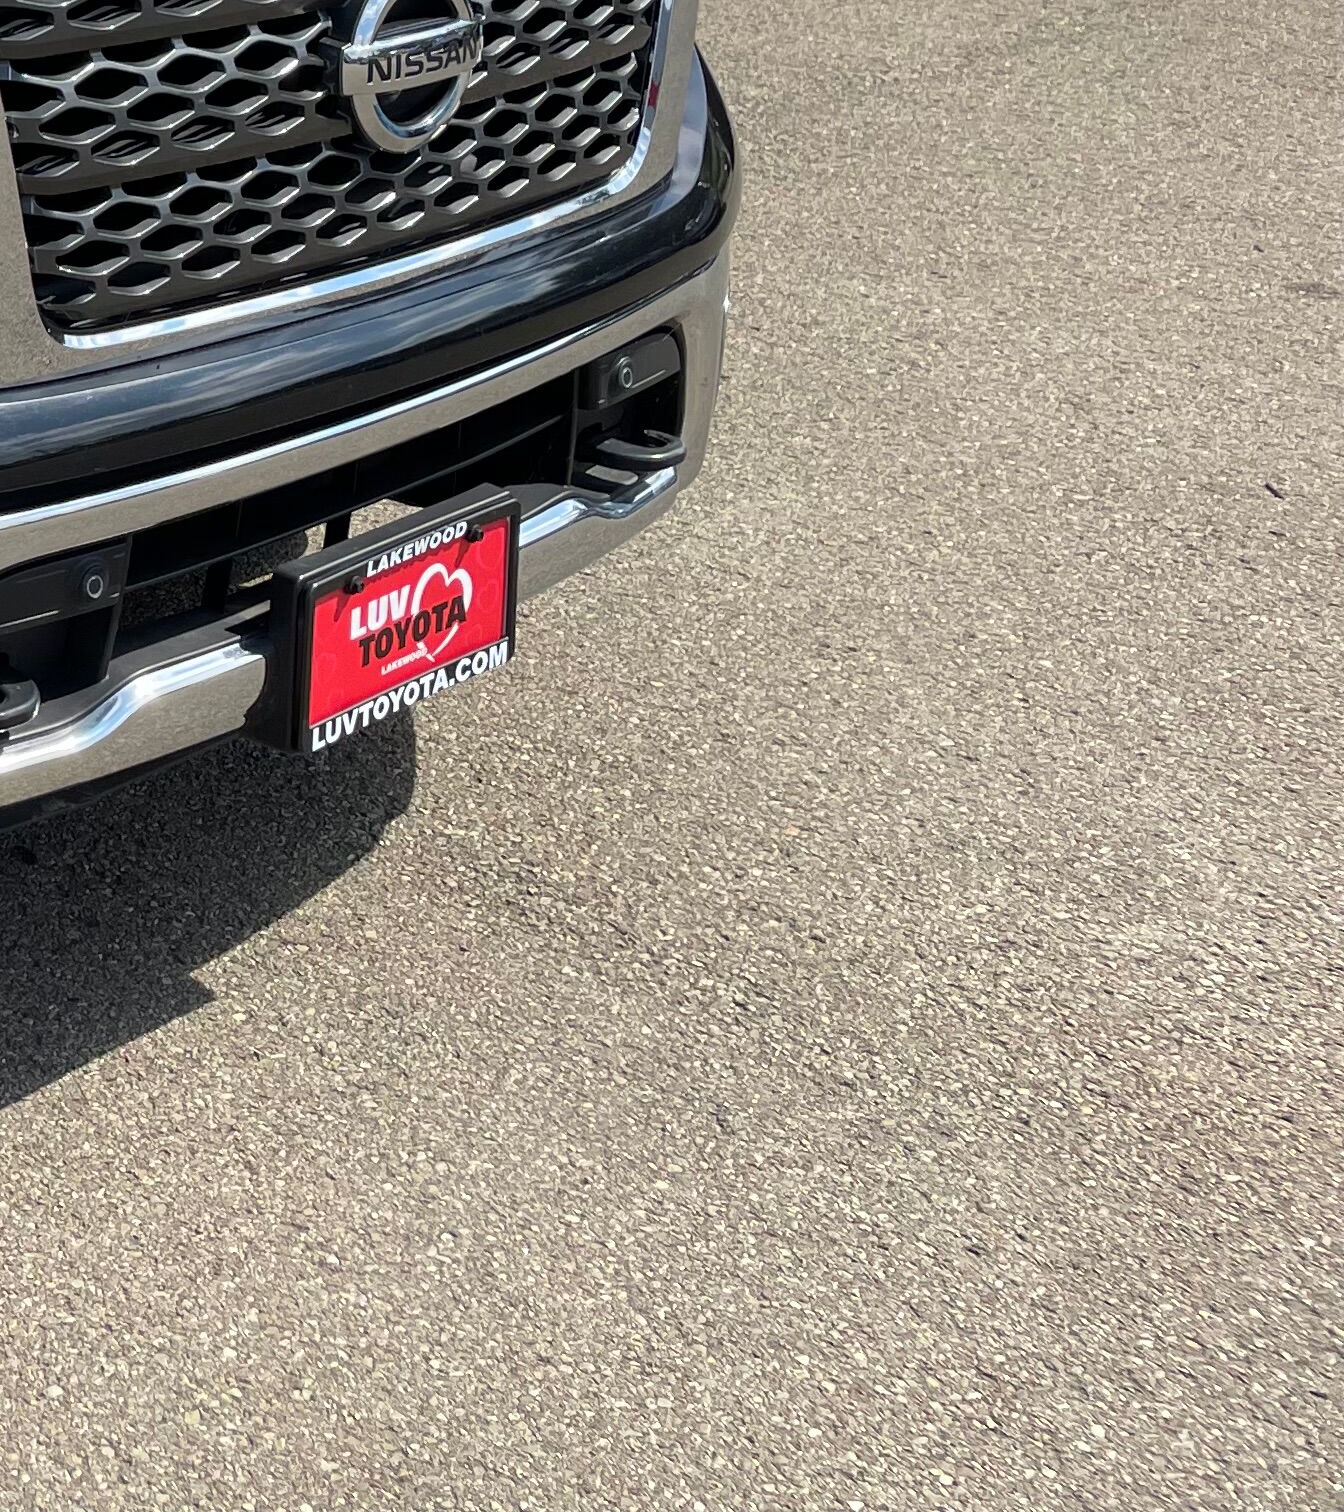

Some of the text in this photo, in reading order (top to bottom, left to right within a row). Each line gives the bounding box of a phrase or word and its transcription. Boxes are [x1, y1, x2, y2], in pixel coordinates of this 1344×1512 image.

[366, 36, 480, 85] NISSAN
[366, 522, 468, 577] LAKEWOOD
[350, 585, 410, 639] LUV
[358, 594, 468, 668] TOYOTA
[312, 642, 508, 751] LUVTOYOTA.COM
